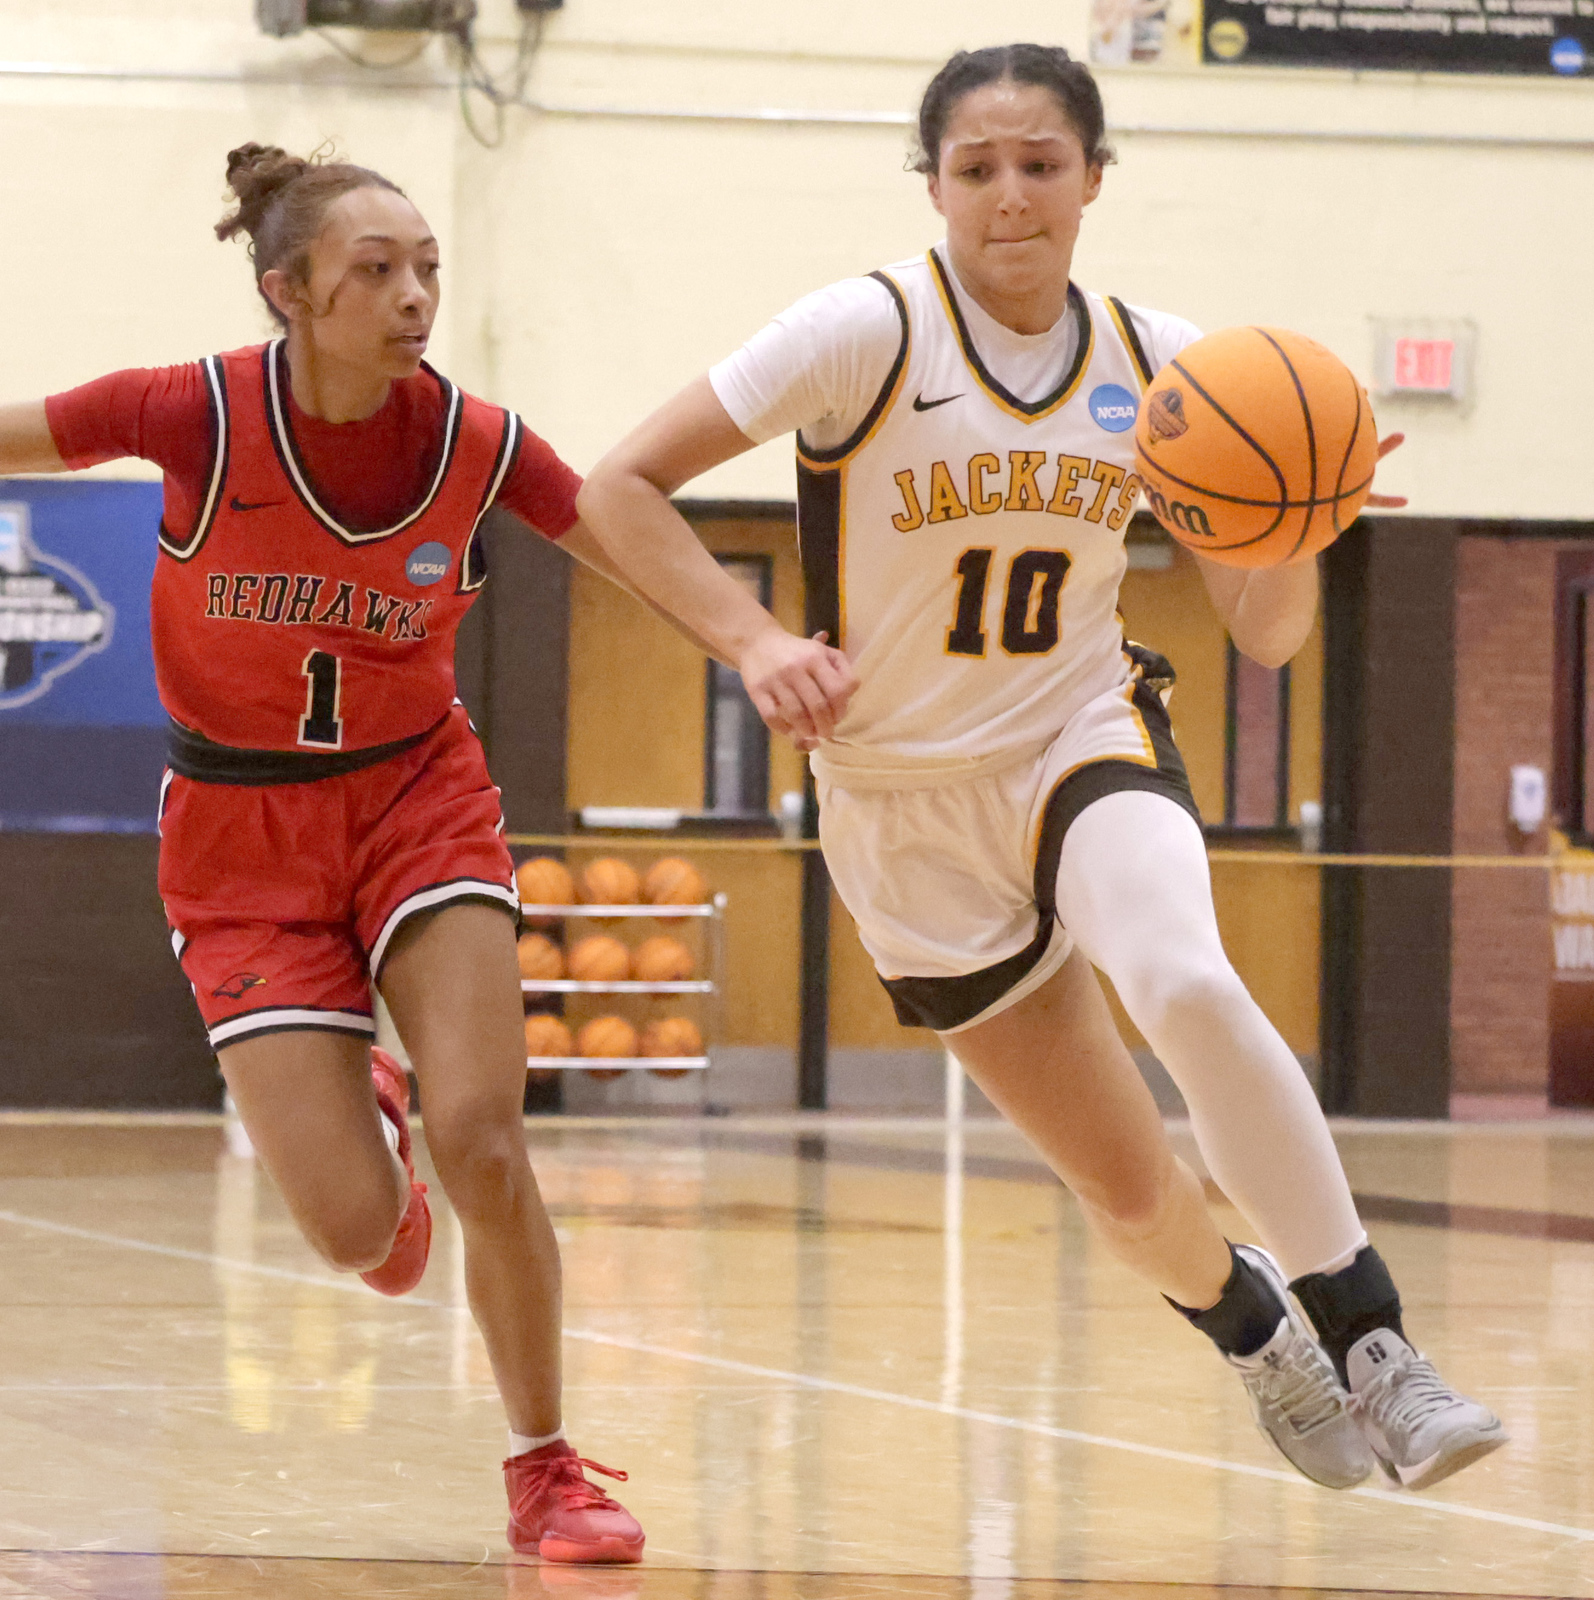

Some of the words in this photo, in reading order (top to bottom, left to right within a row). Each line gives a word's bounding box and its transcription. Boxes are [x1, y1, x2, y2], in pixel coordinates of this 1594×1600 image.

[1097, 405, 1135, 420] NCAA
[891, 450, 1140, 533] JACKETS
[205, 572, 434, 641] REDHAWKS
[409, 562, 447, 576] NCAA
[943, 545, 1073, 659] 10
[297, 647, 343, 750] 1
